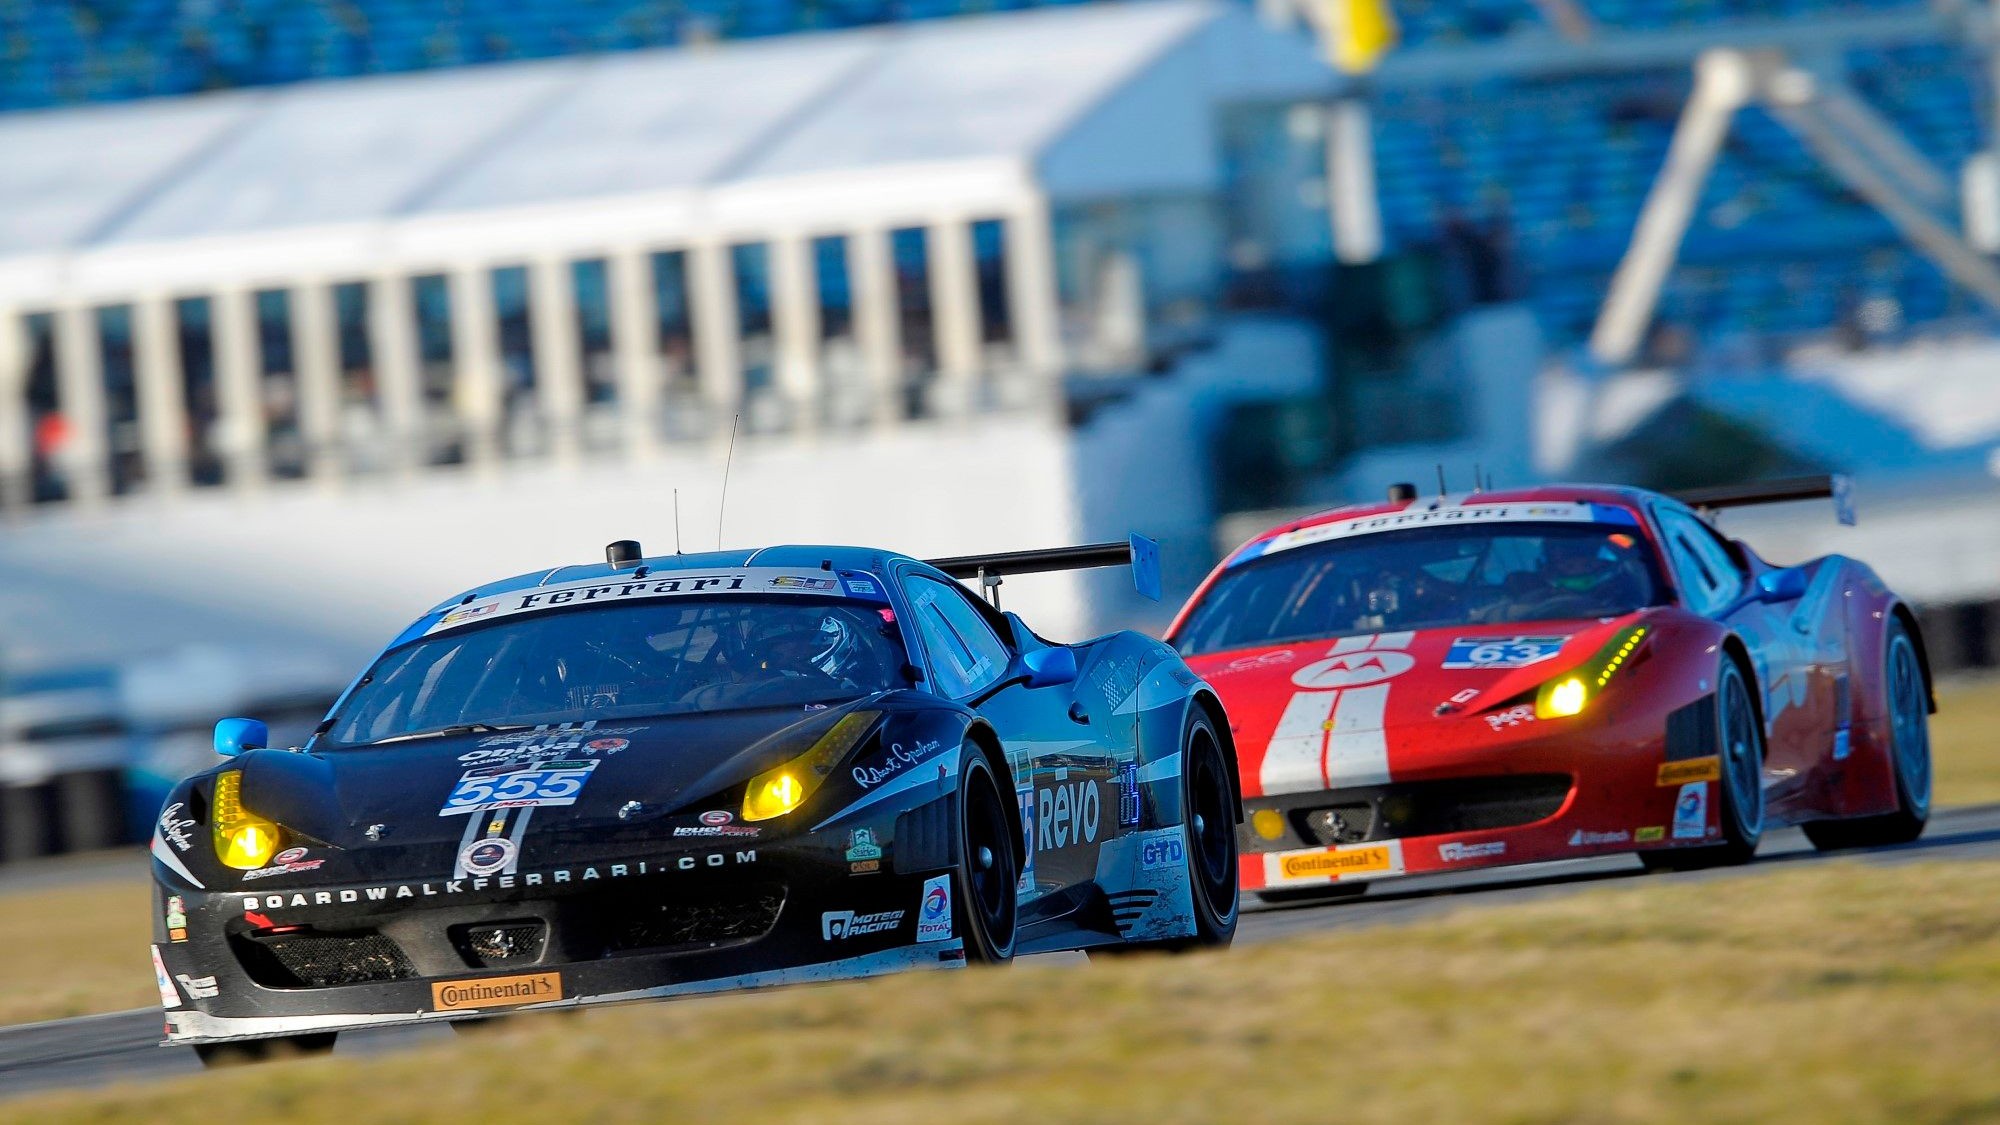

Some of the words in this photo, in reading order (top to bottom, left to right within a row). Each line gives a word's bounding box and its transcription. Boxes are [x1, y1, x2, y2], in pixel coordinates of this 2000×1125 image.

[514, 574, 746, 610] Ferrari
[1468, 644, 1542, 663] 63
[891, 740, 940, 765] Graham
[448, 771, 587, 806] 555
[1143, 839, 1184, 865] GTD
[1286, 851, 1369, 876] Continental
[243, 850, 757, 910] BOARDWALKFERRARI.COM
[849, 920, 900, 935] RACING
[852, 910, 905, 925] MOTEGI
[919, 924, 950, 933] TOTAL
[441, 980, 536, 1006] Continental
